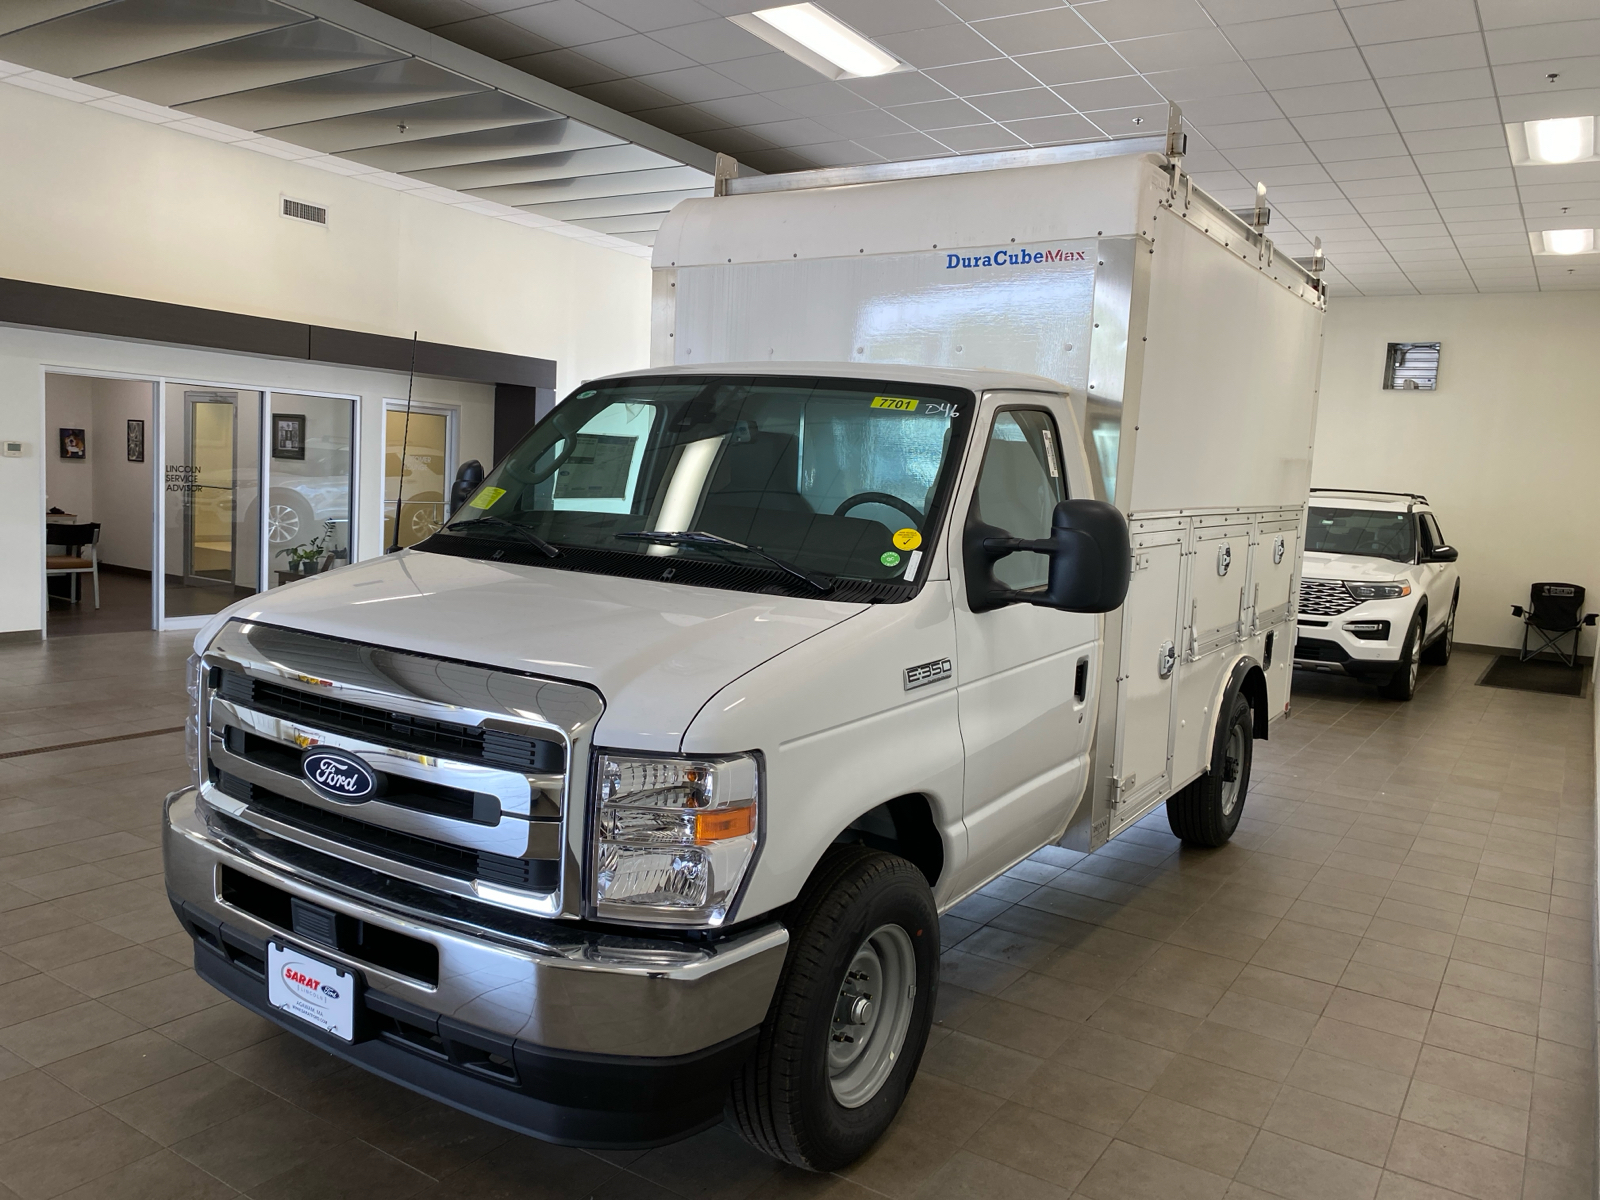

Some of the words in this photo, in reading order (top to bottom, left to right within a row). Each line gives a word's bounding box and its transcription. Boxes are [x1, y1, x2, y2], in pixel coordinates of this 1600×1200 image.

[946, 248, 1085, 269] DuraCubeMax
[879, 398, 911, 410] 7701
[925, 403, 960, 417] D46
[165, 465, 202, 473] LINCOLN
[165, 474, 199, 483] SERVICE
[165, 484, 203, 492] ADVISOR
[316, 758, 359, 792] Ford
[285, 968, 320, 991] SARAT
